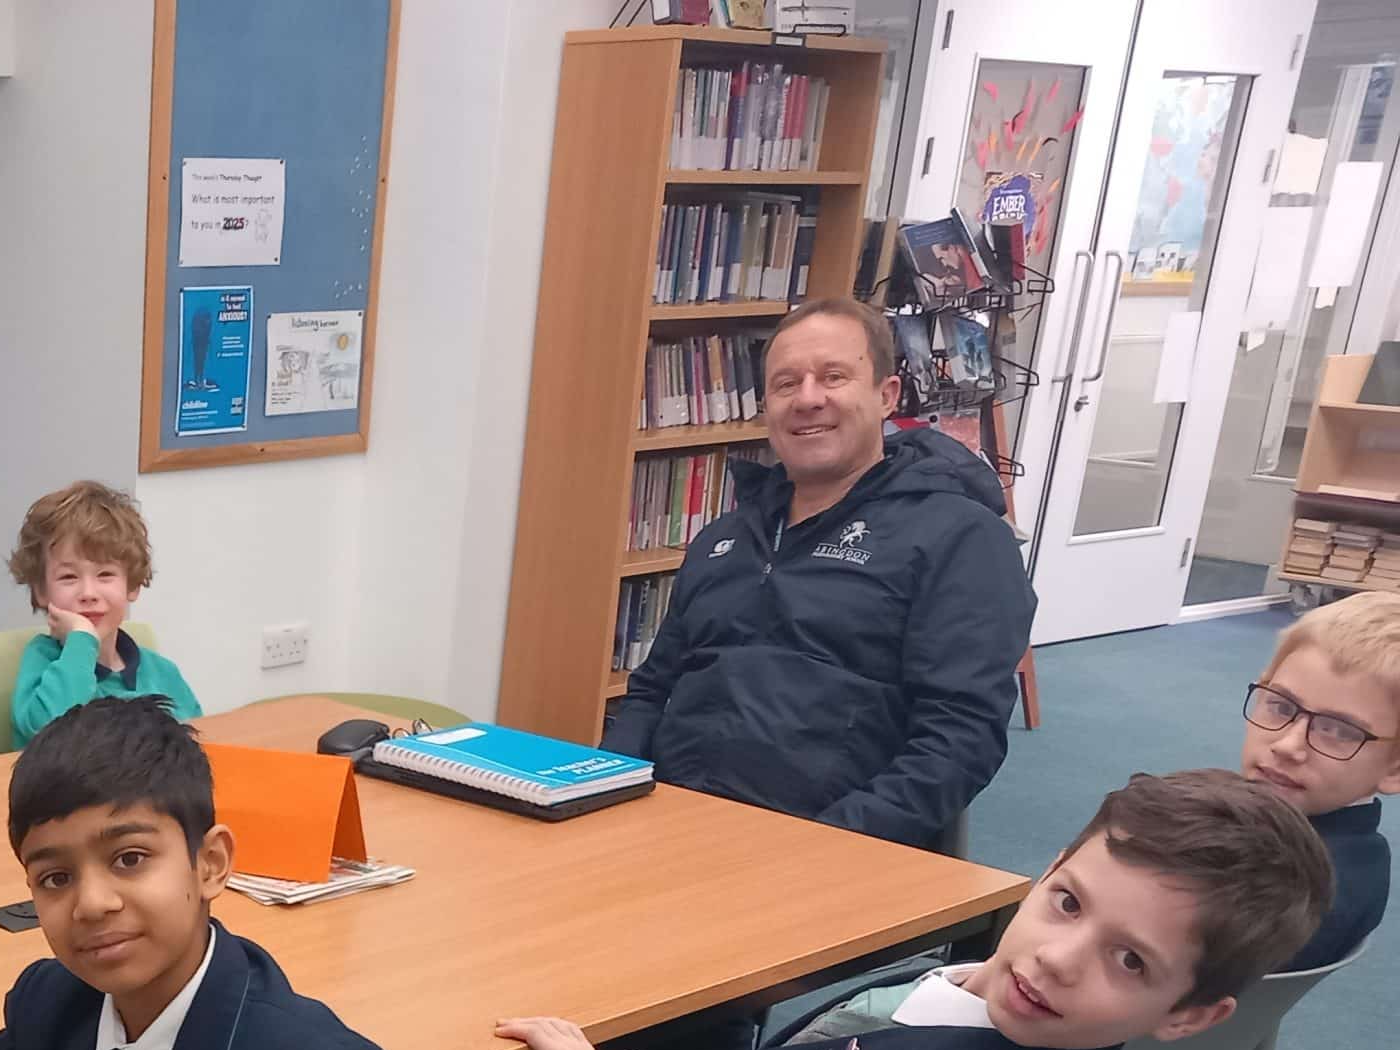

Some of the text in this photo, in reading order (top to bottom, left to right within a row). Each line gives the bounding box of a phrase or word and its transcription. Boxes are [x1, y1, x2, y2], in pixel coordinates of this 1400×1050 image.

[191, 194, 212, 204] What
[220, 195, 239, 204] most
[241, 195, 275, 206] important
[992, 194, 1026, 215] EMBER
[200, 221, 213, 231] you
